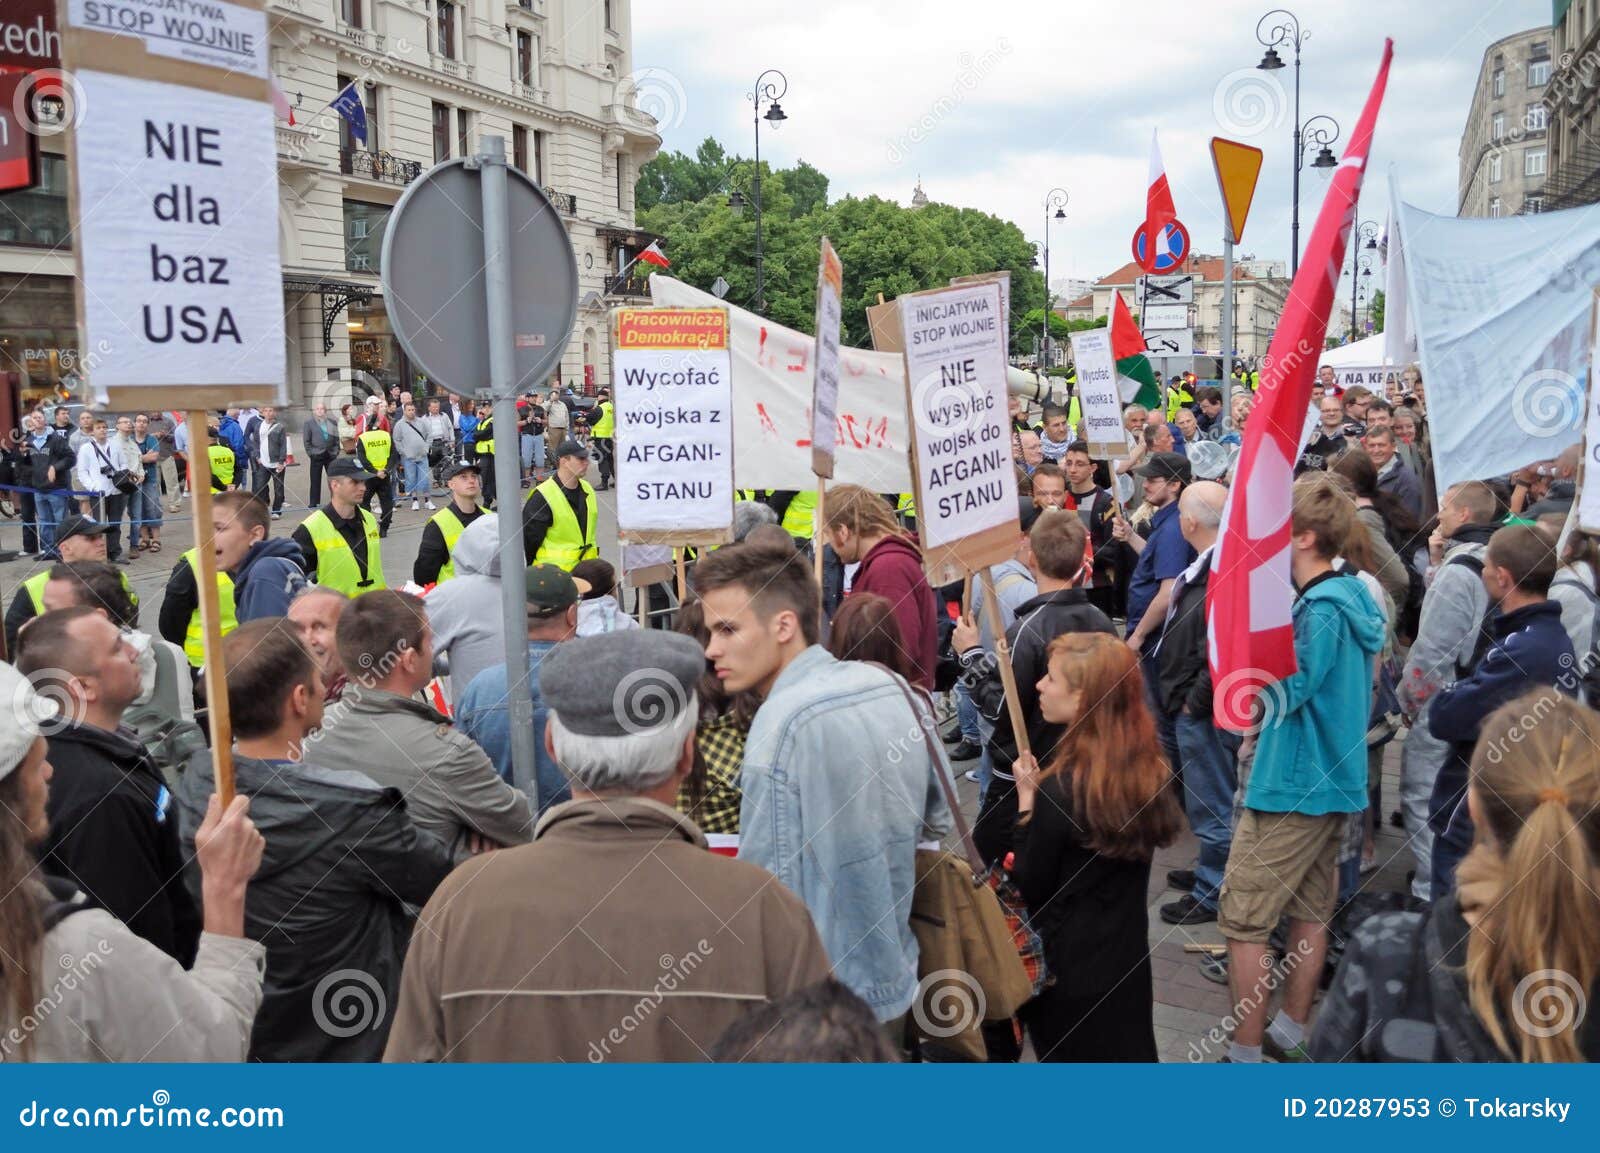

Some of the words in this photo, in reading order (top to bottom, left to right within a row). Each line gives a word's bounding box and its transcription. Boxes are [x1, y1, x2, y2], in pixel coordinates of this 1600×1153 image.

[84, 1, 155, 31] STOP
[163, 15, 254, 53] WOJNIE
[144, 120, 223, 166] NIE
[152, 184, 220, 225] dla
[151, 243, 230, 285] baz
[143, 305, 242, 344] USA
[622, 312, 722, 326] Pracownicza
[916, 298, 989, 323] INICJATYWA
[626, 330, 719, 346] Demokracja
[913, 327, 946, 345] STOP
[949, 317, 996, 338] WOJNIE
[624, 367, 720, 391] Wycofać
[940, 359, 977, 388] NIE
[1345, 372, 1364, 384] NA
[625, 406, 701, 429] wojska
[709, 410, 720, 423] z
[928, 390, 994, 426] wysyłać
[367, 440, 387, 448] POLICJA
[627, 443, 721, 462] AFGANI-
[928, 429, 977, 457] wojsk
[980, 423, 1001, 442] do
[929, 449, 1007, 490] AFGANI-
[637, 481, 712, 500] STANU
[938, 479, 1003, 519] STANU
